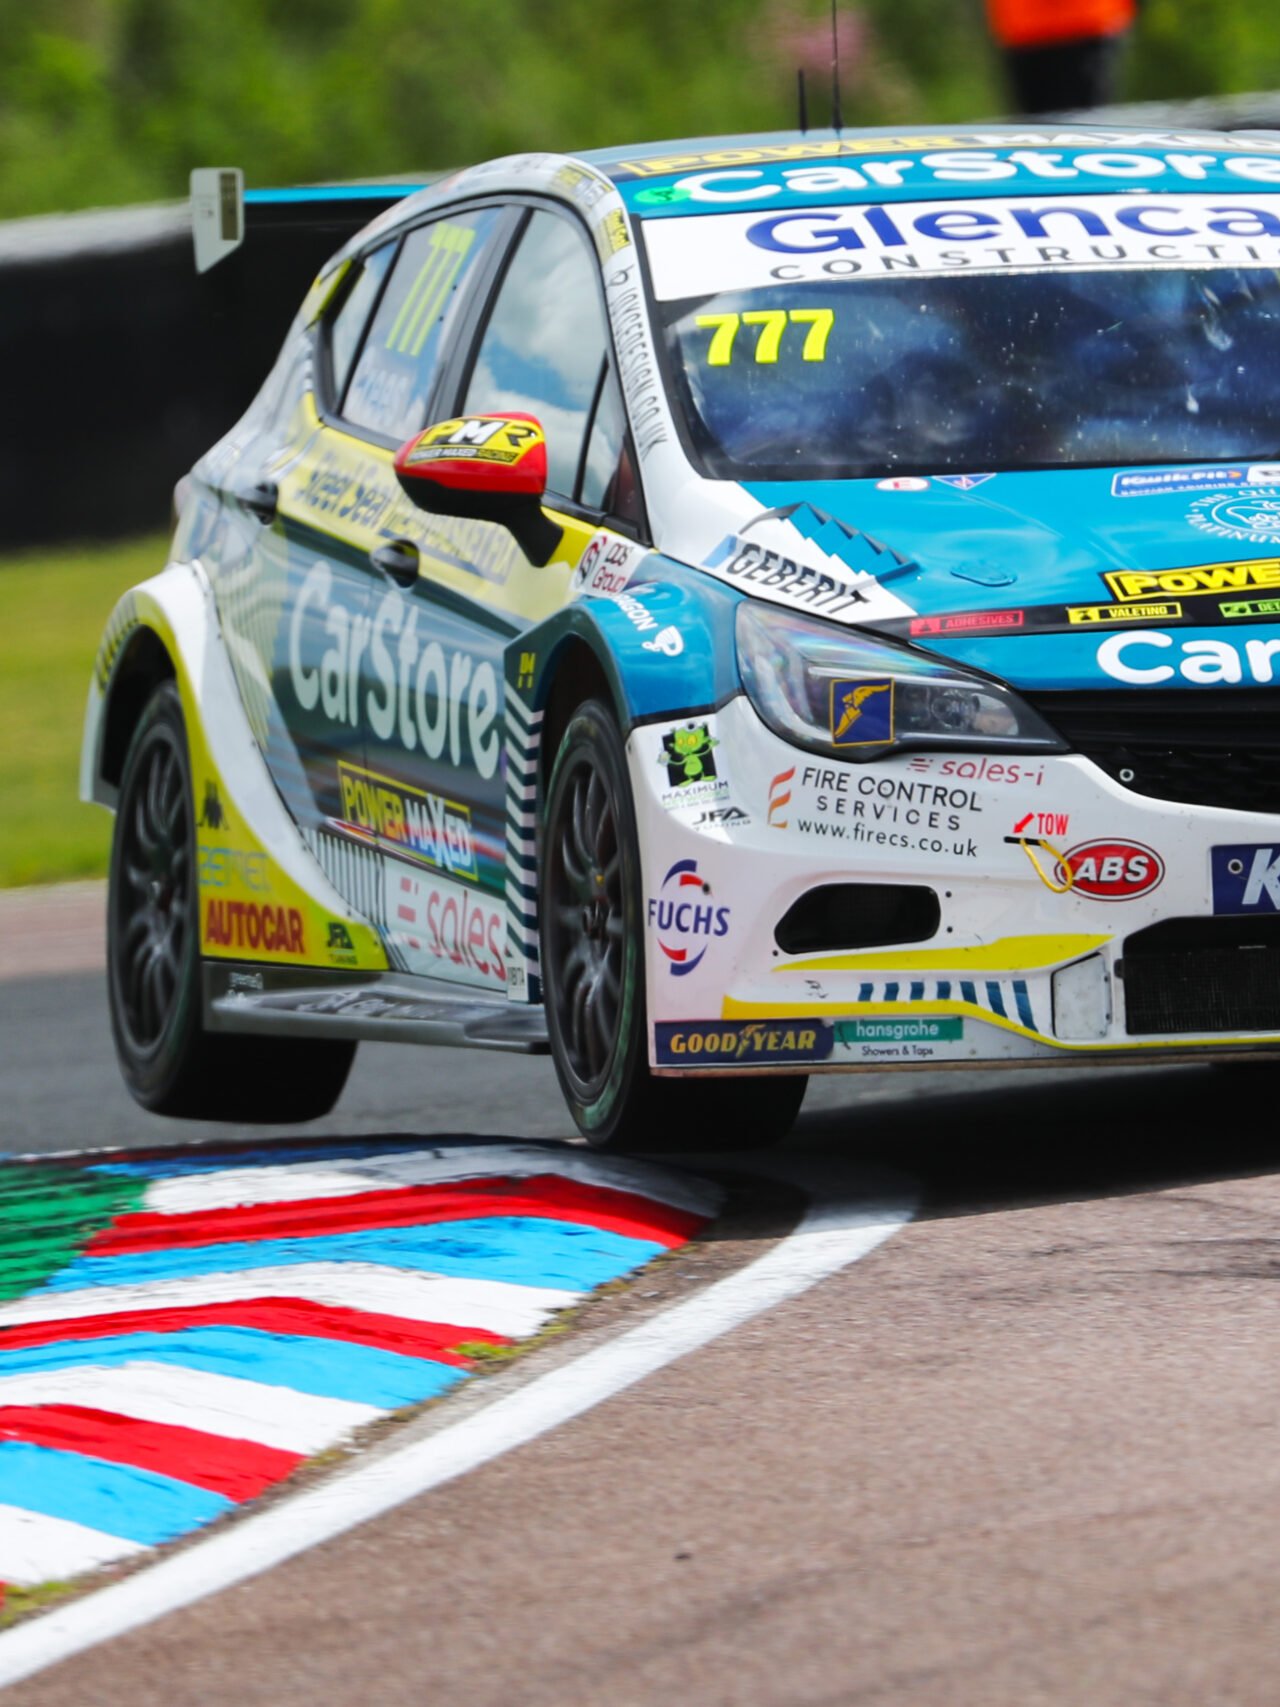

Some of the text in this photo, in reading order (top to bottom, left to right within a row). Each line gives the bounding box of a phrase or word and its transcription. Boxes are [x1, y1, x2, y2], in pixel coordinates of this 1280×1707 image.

[695, 308, 834, 366] 777
[419, 420, 538, 446] PMR
[727, 542, 871, 614] GEBERIT
[945, 614, 1014, 629] ADHESIVES
[1108, 605, 1168, 618] VALETING
[290, 560, 500, 780] CarStore
[938, 758, 1046, 786] sales-i
[662, 780, 729, 800] MAXIMUM
[801, 766, 983, 812] FIRE CONTROL
[342, 775, 474, 872] POWER MAXED
[692, 806, 749, 826] JFA
[815, 796, 962, 832] SERVICES
[1037, 814, 1070, 836] TOW
[797, 817, 979, 858] www.firecs.co.uk
[1072, 856, 1150, 883] ABS
[206, 899, 305, 954] AUTOCAR
[648, 898, 732, 937] FUCHS
[855, 1018, 940, 1041] hansgrohe
[861, 1045, 934, 1059] Showers & Taps
